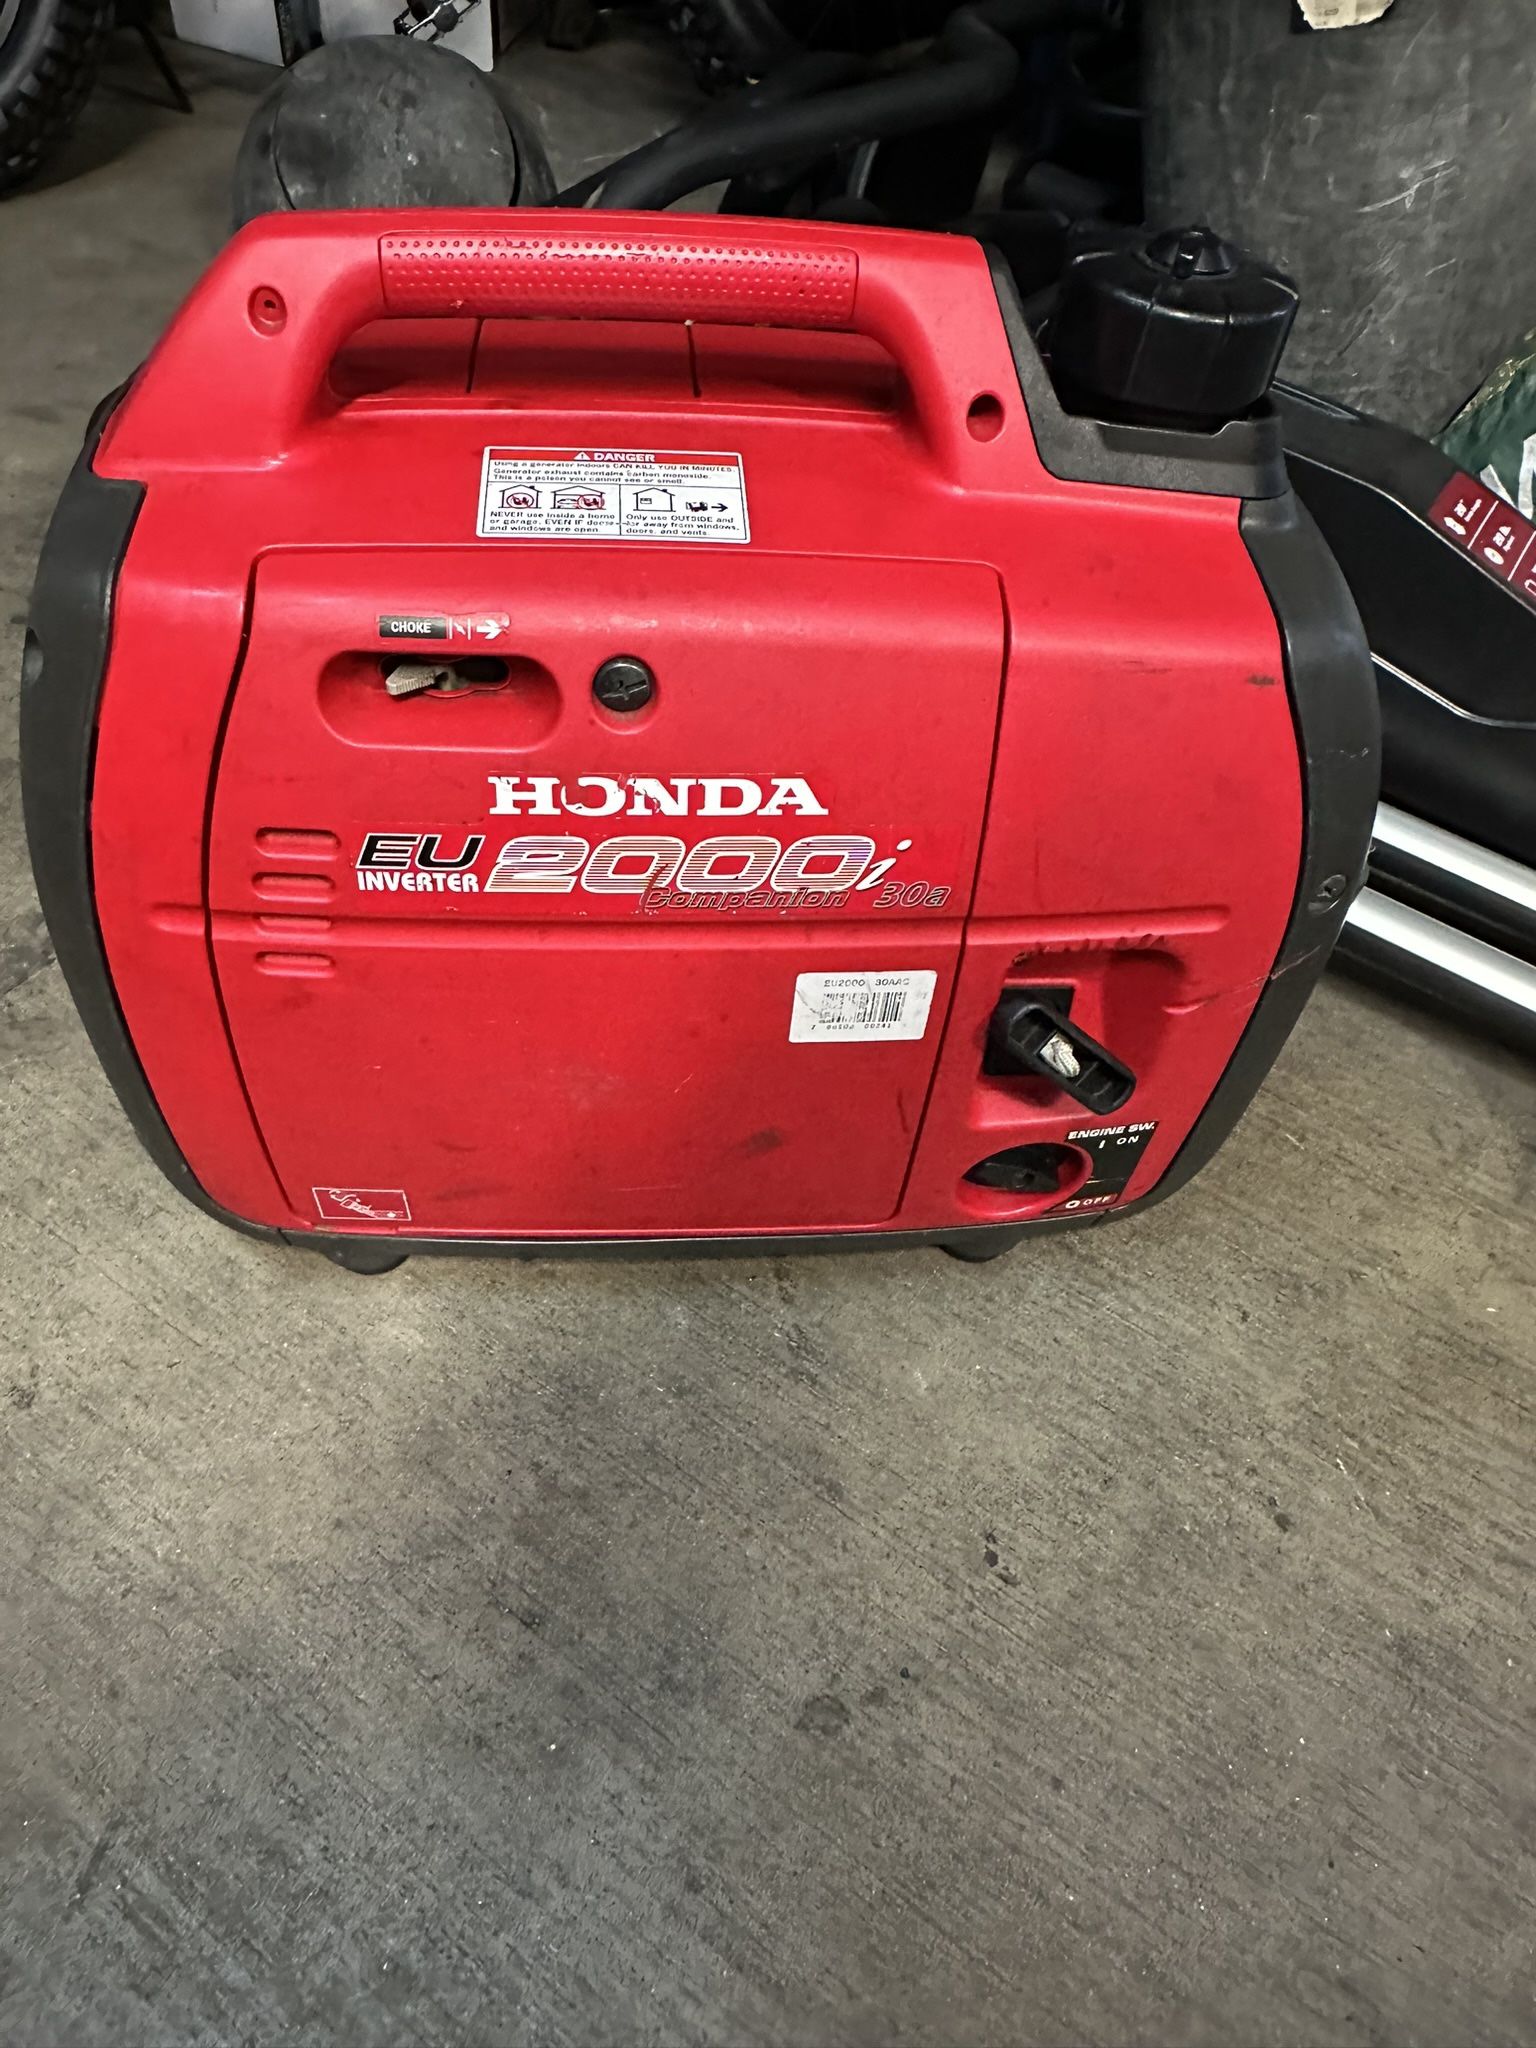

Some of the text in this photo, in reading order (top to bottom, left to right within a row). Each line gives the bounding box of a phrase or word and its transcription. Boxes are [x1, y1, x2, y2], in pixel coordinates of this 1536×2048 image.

[594, 452, 656, 462] DANGER
[626, 513, 648, 521] Only
[391, 621, 431, 633] CHOKE
[487, 776, 829, 816] HONDA
[355, 832, 486, 871] EU
[356, 870, 480, 893] INVERTER
[643, 880, 951, 912] Companion 30a
[1068, 1122, 1155, 1139] ENGINE SW.
[1116, 1135, 1139, 1145] ON
[1083, 1196, 1111, 1205] OFF
